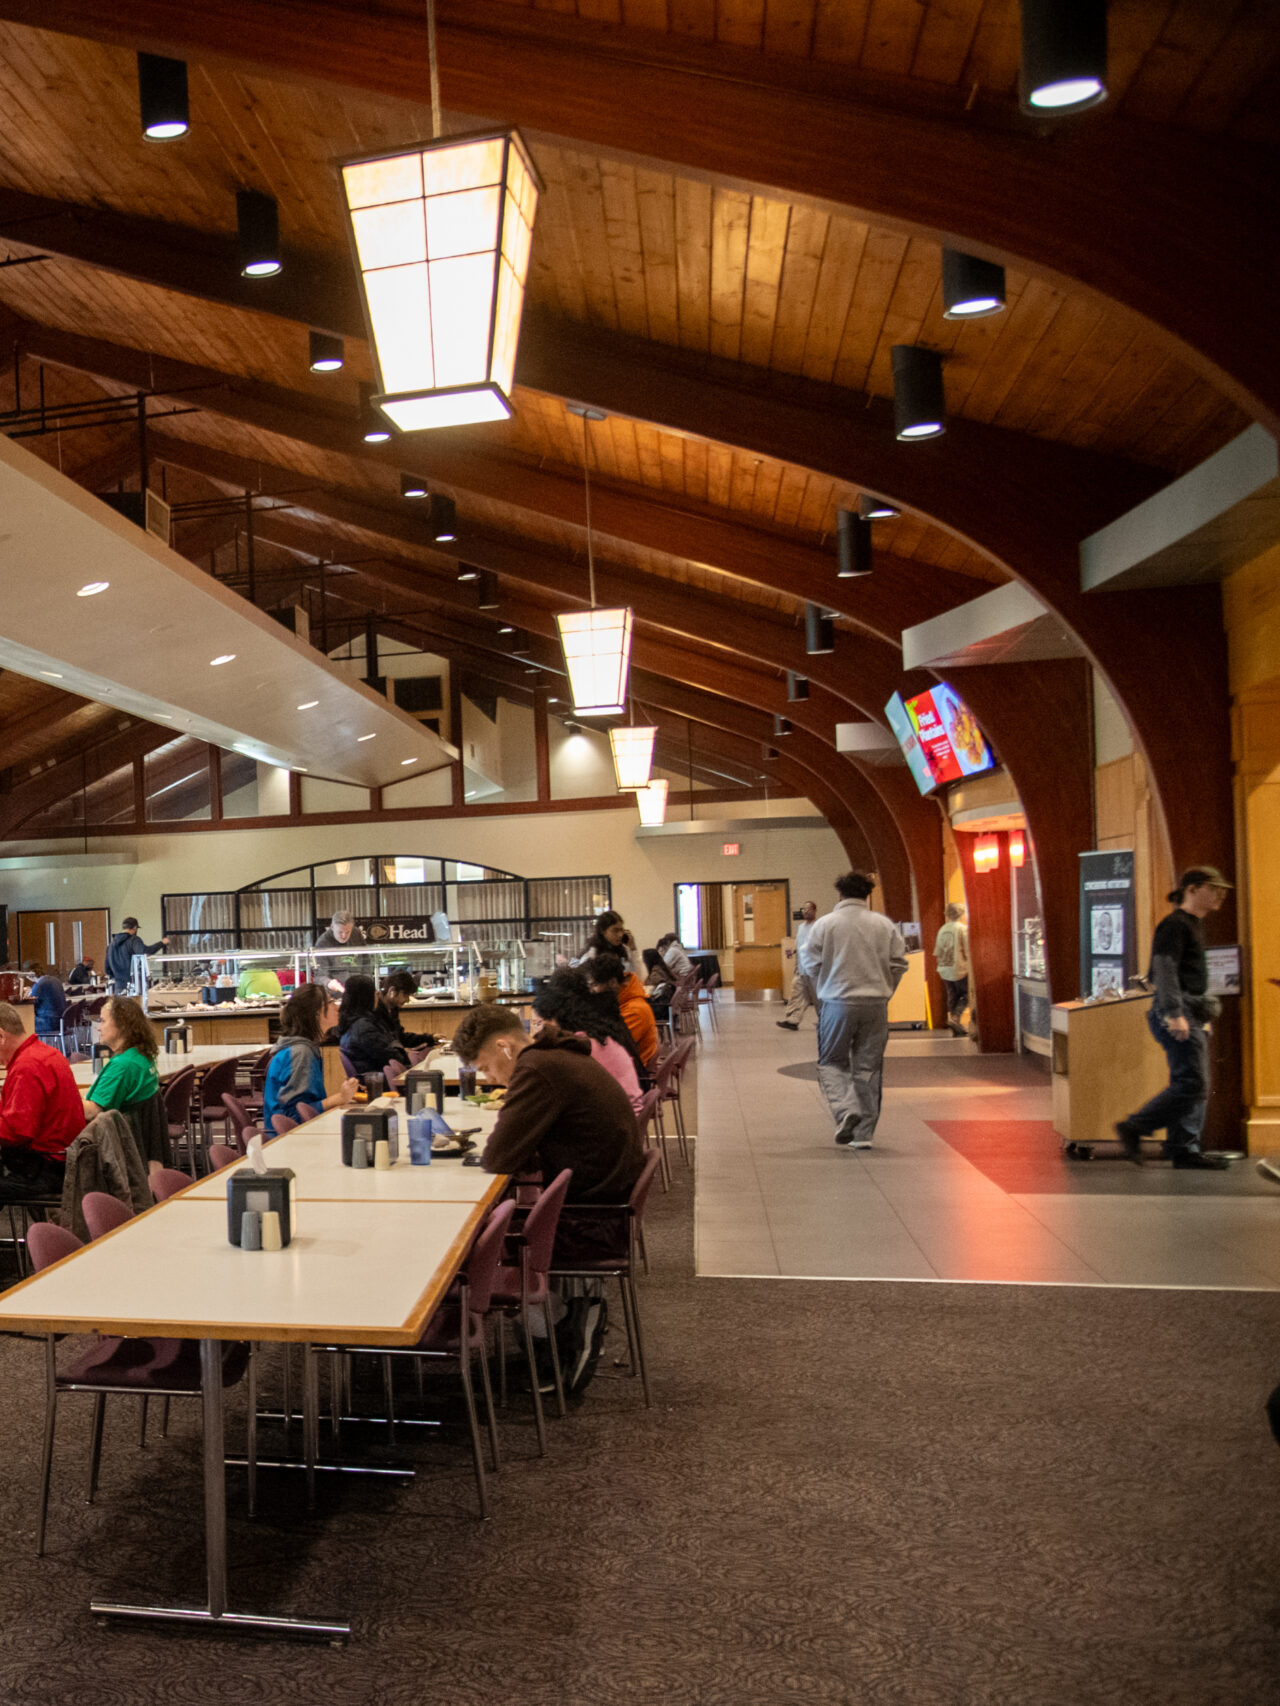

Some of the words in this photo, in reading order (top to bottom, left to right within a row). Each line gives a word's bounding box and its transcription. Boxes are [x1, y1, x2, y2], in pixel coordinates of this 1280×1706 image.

[918, 710, 936, 727] Fried
[725, 845, 737, 855] EXIT
[388, 923, 428, 939] Head
